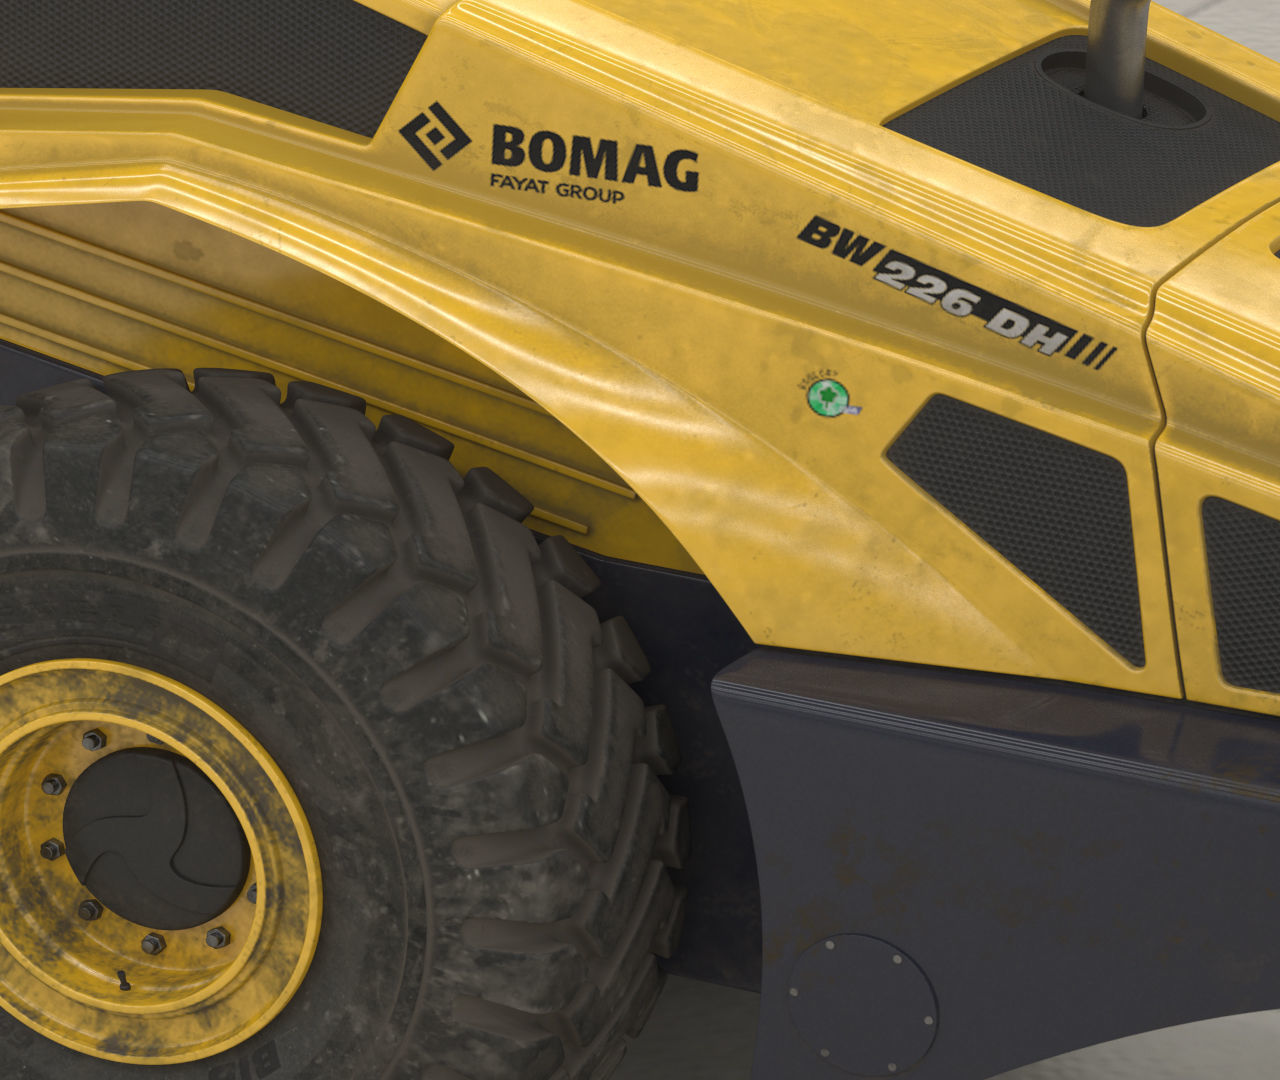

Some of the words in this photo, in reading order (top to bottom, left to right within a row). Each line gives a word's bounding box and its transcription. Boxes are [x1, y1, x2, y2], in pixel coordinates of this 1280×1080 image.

[491, 124, 699, 192] BOMAG
[489, 173, 549, 195] FAYAT
[556, 183, 625, 205] GROUP
[984, 307, 1071, 356] DH
